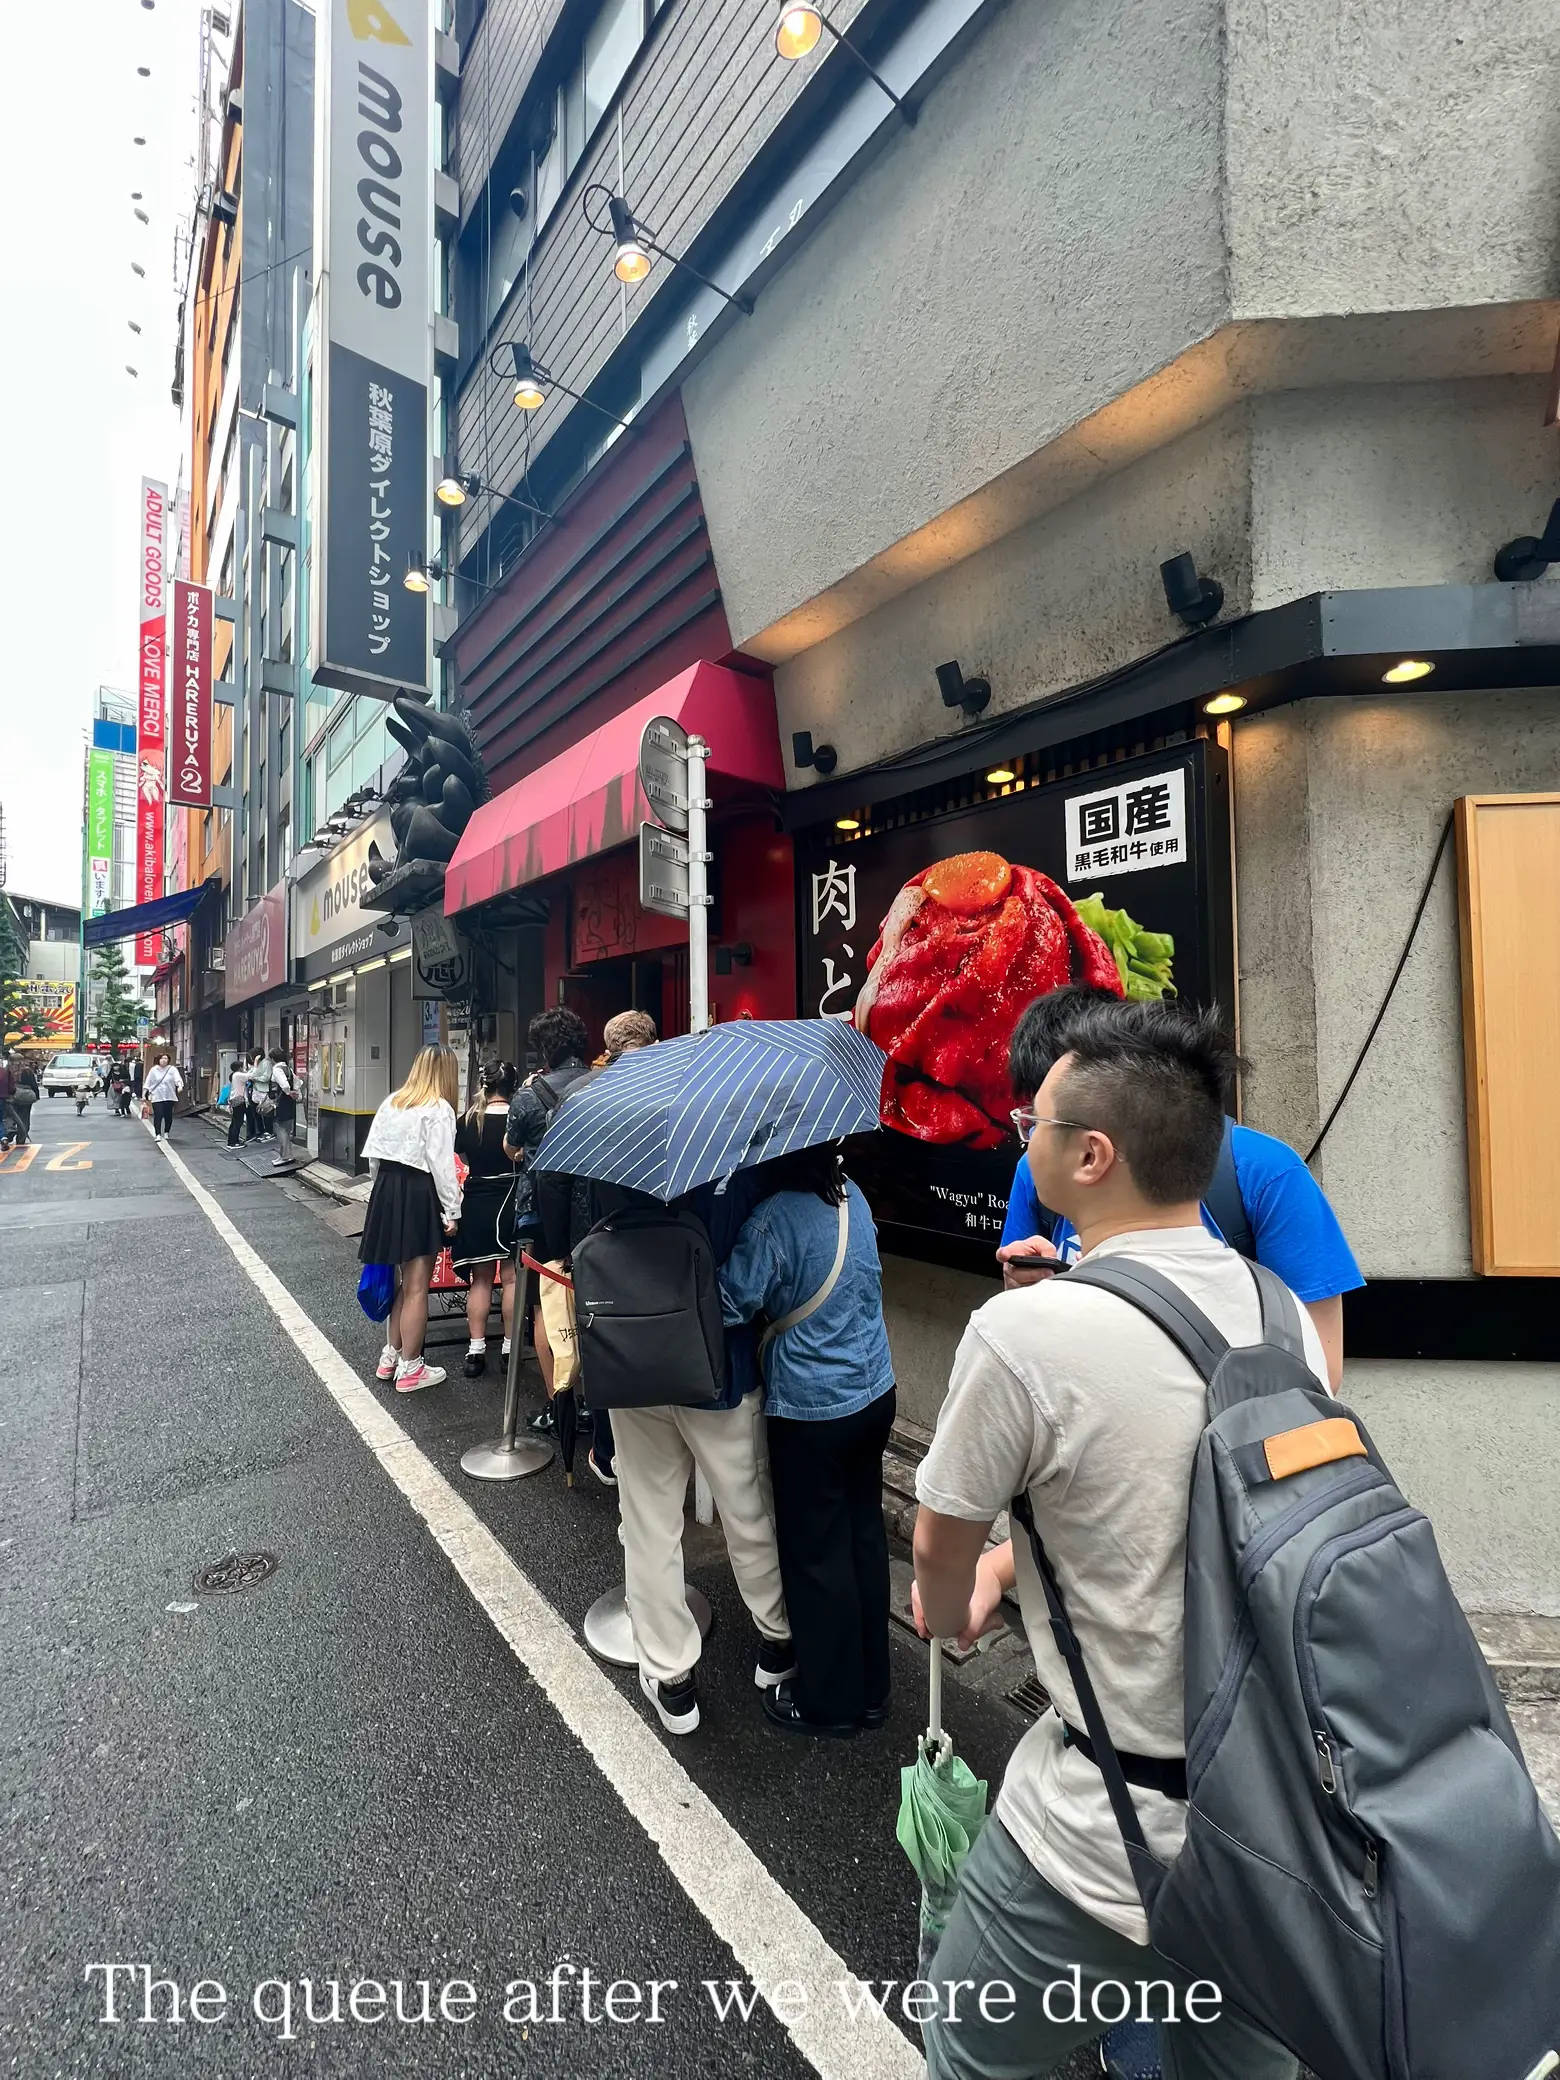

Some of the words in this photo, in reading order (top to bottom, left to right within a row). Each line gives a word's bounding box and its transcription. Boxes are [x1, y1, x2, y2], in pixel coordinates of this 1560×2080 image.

[357, 60, 402, 309] mouse
[145, 487, 162, 544] ADULT
[368, 381, 393, 654] 秋葉原ダイレクトショップ
[145, 546, 162, 608] GOODS
[143, 634, 161, 679] LOVE
[186, 591, 200, 662] ポケカ専門店
[143, 681, 161, 737] MERCI
[184, 664, 200, 767] HARERUYA
[180, 768, 202, 794] 2
[1079, 783, 1171, 847] 国産
[1074, 838, 1179, 872] 黒毛和牛使用
[323, 861, 369, 922] mouse
[930, 1185, 983, 1208] "Wagyu"
